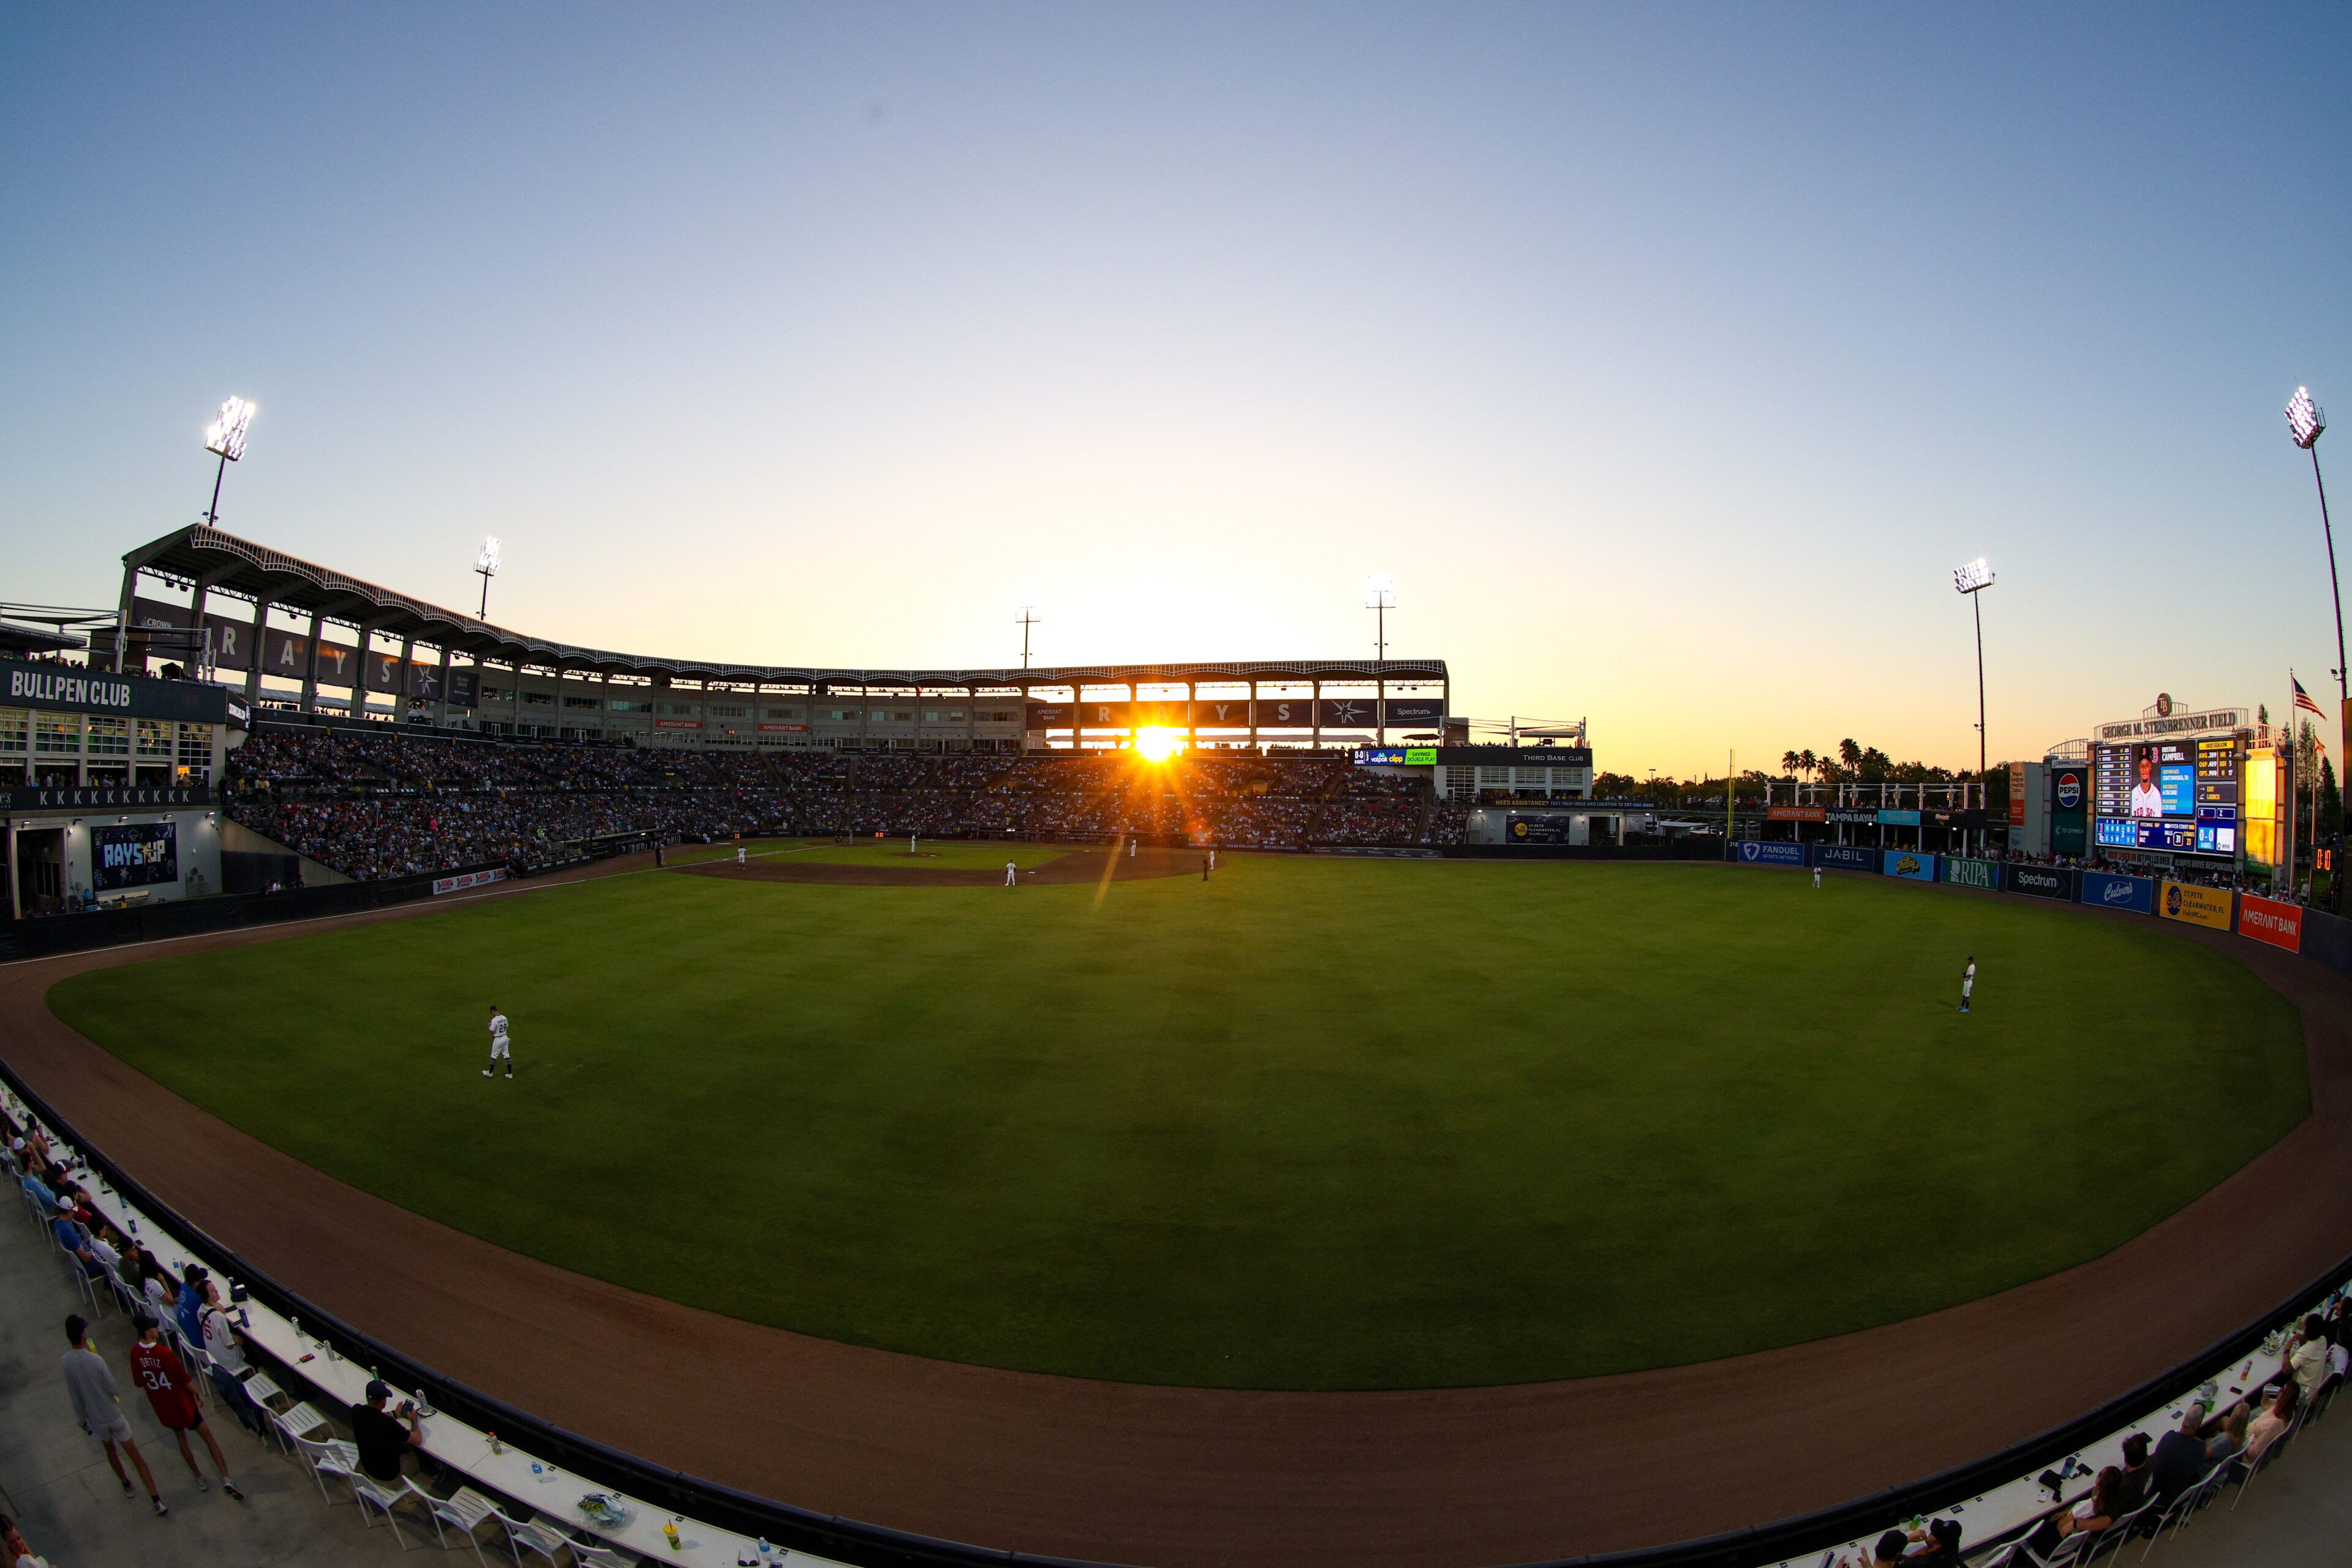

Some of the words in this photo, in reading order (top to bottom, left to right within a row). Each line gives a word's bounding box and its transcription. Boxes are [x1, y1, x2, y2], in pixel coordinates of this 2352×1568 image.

[12, 671, 87, 703] BULLPEN
[91, 680, 130, 707] CLUB
[2103, 725, 2132, 738] GEORGE
[2133, 723, 2143, 736] M.
[2144, 716, 2207, 734] STEINBRENNER
[2209, 712, 2236, 728] FIELD
[40, 791, 48, 805] K
[58, 791, 65, 805] K
[75, 791, 82, 804] K
[91, 791, 98, 804] K
[107, 790, 115, 804] K
[123, 790, 130, 803] K
[138, 790, 145, 803] K
[154, 790, 160, 802] K
[168, 790, 175, 802] K
[183, 790, 189, 802] K
[1825, 813, 1852, 823] TAMPA
[2199, 829, 2214, 842] 0-0
[105, 843, 144, 868] RAYS
[147, 840, 165, 863] UP
[1763, 846, 1800, 855] FANDUEL
[1825, 849, 1863, 861] JABIL
[2175, 858, 2192, 868] ALWAYS
[2192, 860, 2205, 869] DRIVE
[2317, 849, 2331, 870] 0:10
[1960, 861, 1989, 887] RIPA
[2019, 871, 2057, 888] Spectrum
[2104, 882, 2133, 901] Culver's
[2183, 900, 2217, 913] CLEARWATER,
[2243, 909, 2278, 930] AMERANT
[2278, 918, 2297, 937] BANK
[499, 1023, 507, 1033] 28
[139, 1357, 161, 1368] ORTIZ
[142, 1371, 172, 1390] 34
